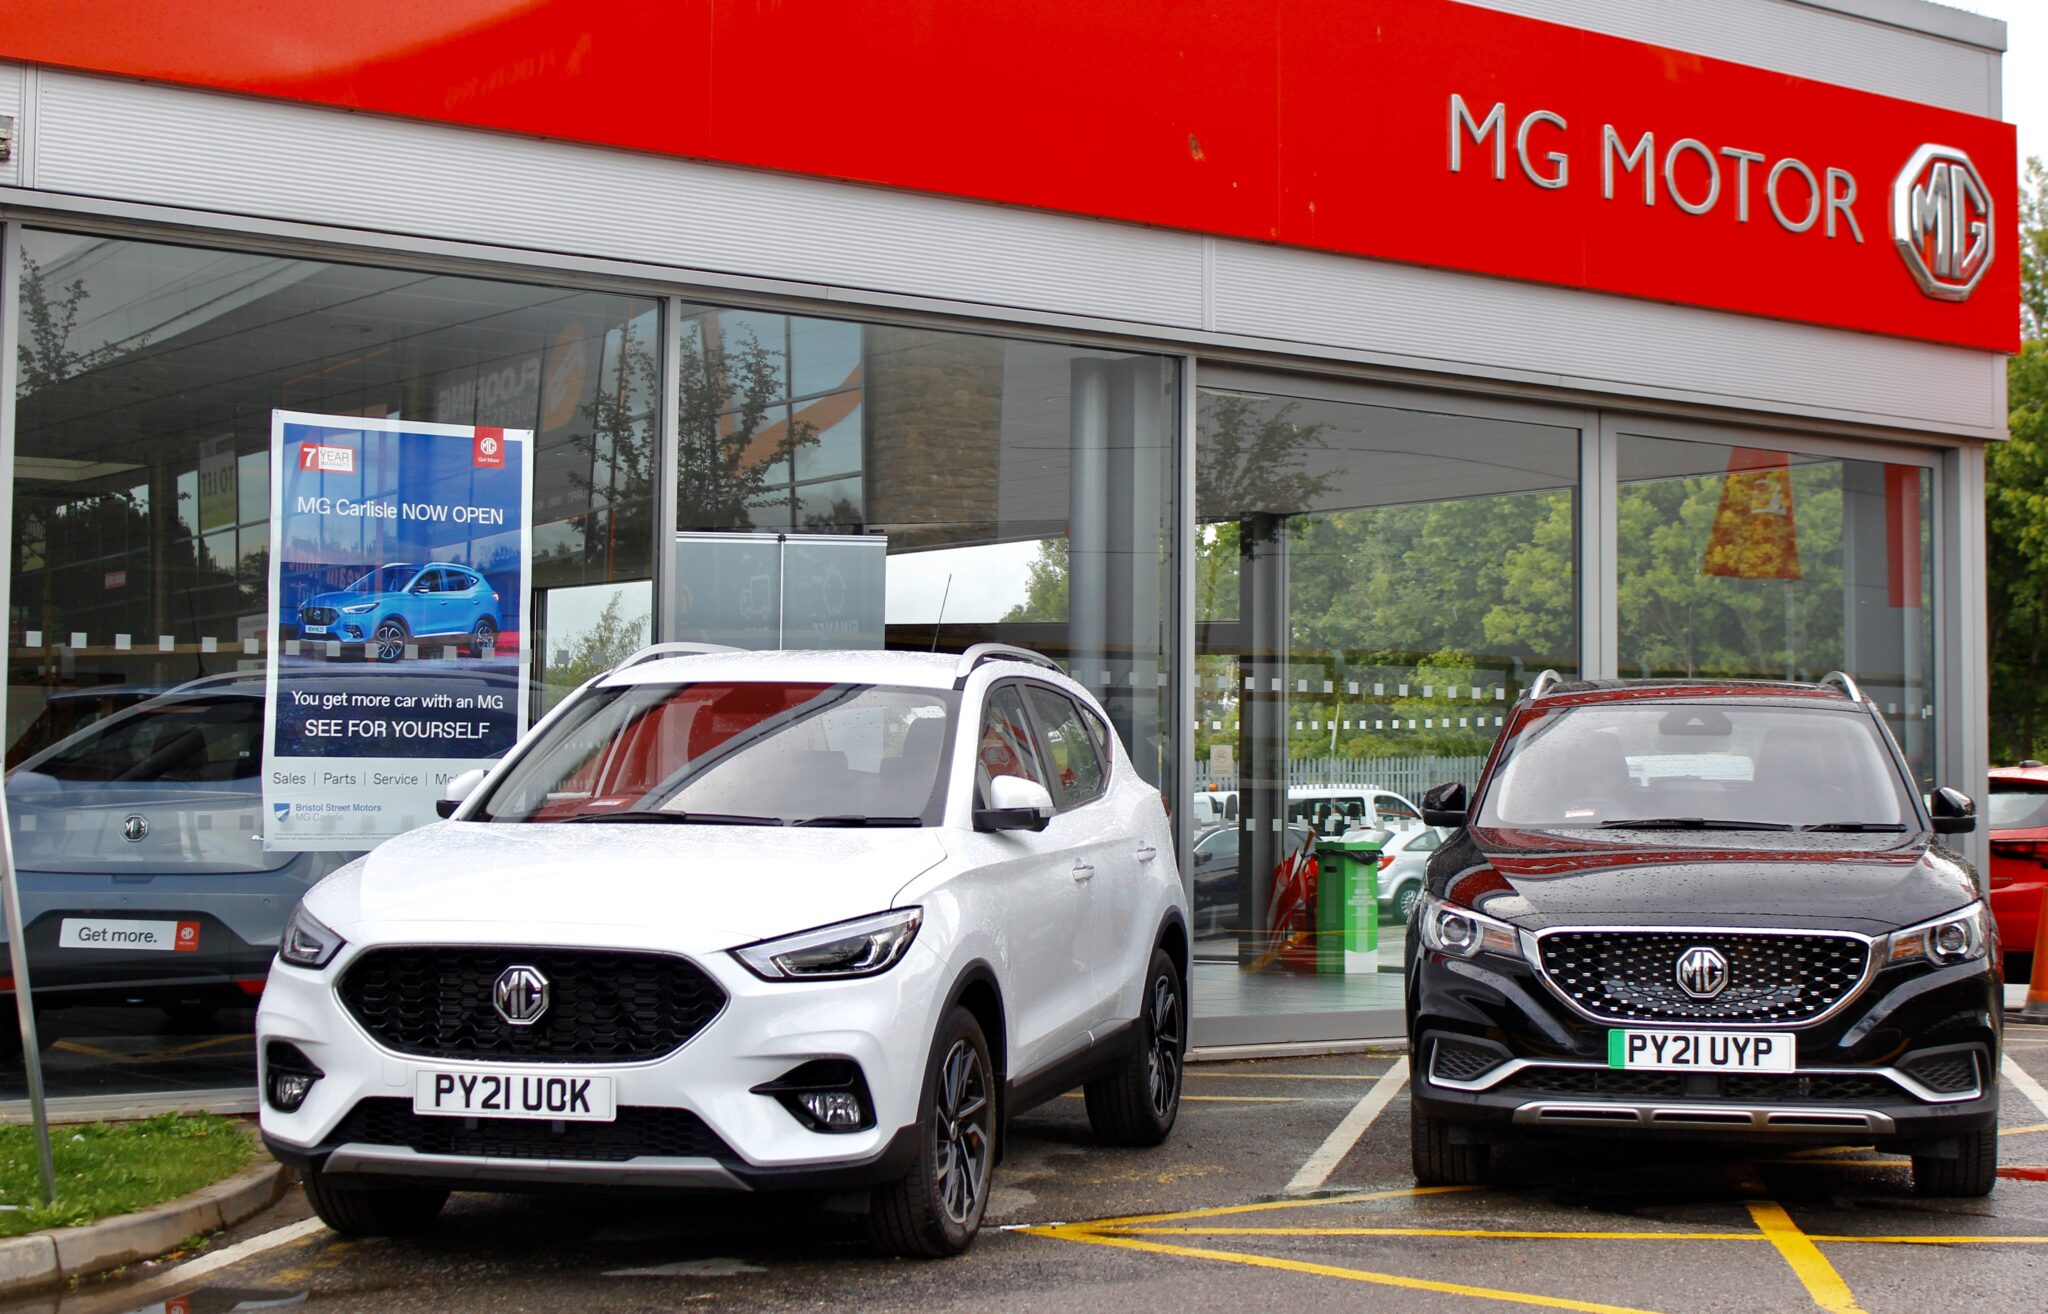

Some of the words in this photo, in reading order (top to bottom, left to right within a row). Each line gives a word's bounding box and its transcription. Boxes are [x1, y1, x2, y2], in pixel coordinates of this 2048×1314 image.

[1448, 94, 1569, 189] MG
[1603, 124, 1865, 244] MOTOR
[1902, 153, 1990, 290] MG
[303, 447, 317, 467] 7
[320, 450, 350, 462] YEAR
[297, 496, 331, 515] MG
[336, 498, 398, 519] Carlisle
[402, 502, 448, 522] NOW
[452, 505, 503, 525] OPEN
[292, 690, 319, 706] You
[322, 692, 348, 710] get
[351, 694, 390, 707] more
[394, 696, 418, 708] car
[421, 693, 453, 708] with
[456, 697, 473, 709] an
[477, 694, 504, 710] MG
[304, 718, 343, 737] SEE
[347, 719, 387, 738] FOR
[391, 720, 491, 739] YOURSELF
[273, 771, 307, 785] Sales
[323, 772, 357, 786] Parts
[373, 773, 419, 786] Service
[295, 803, 323, 812] Bristol
[325, 803, 351, 812] Street
[352, 804, 382, 812] Motors
[295, 813, 311, 822] MG
[312, 813, 344, 822] Cale
[78, 926, 108, 942] Get
[111, 930, 157, 943] more.
[1680, 949, 1725, 995] MG
[498, 968, 544, 1020] MG
[1628, 1034, 1699, 1065] PY21
[1710, 1036, 1773, 1066] UYP
[435, 1073, 511, 1110] PY21
[522, 1077, 591, 1113] UOK
